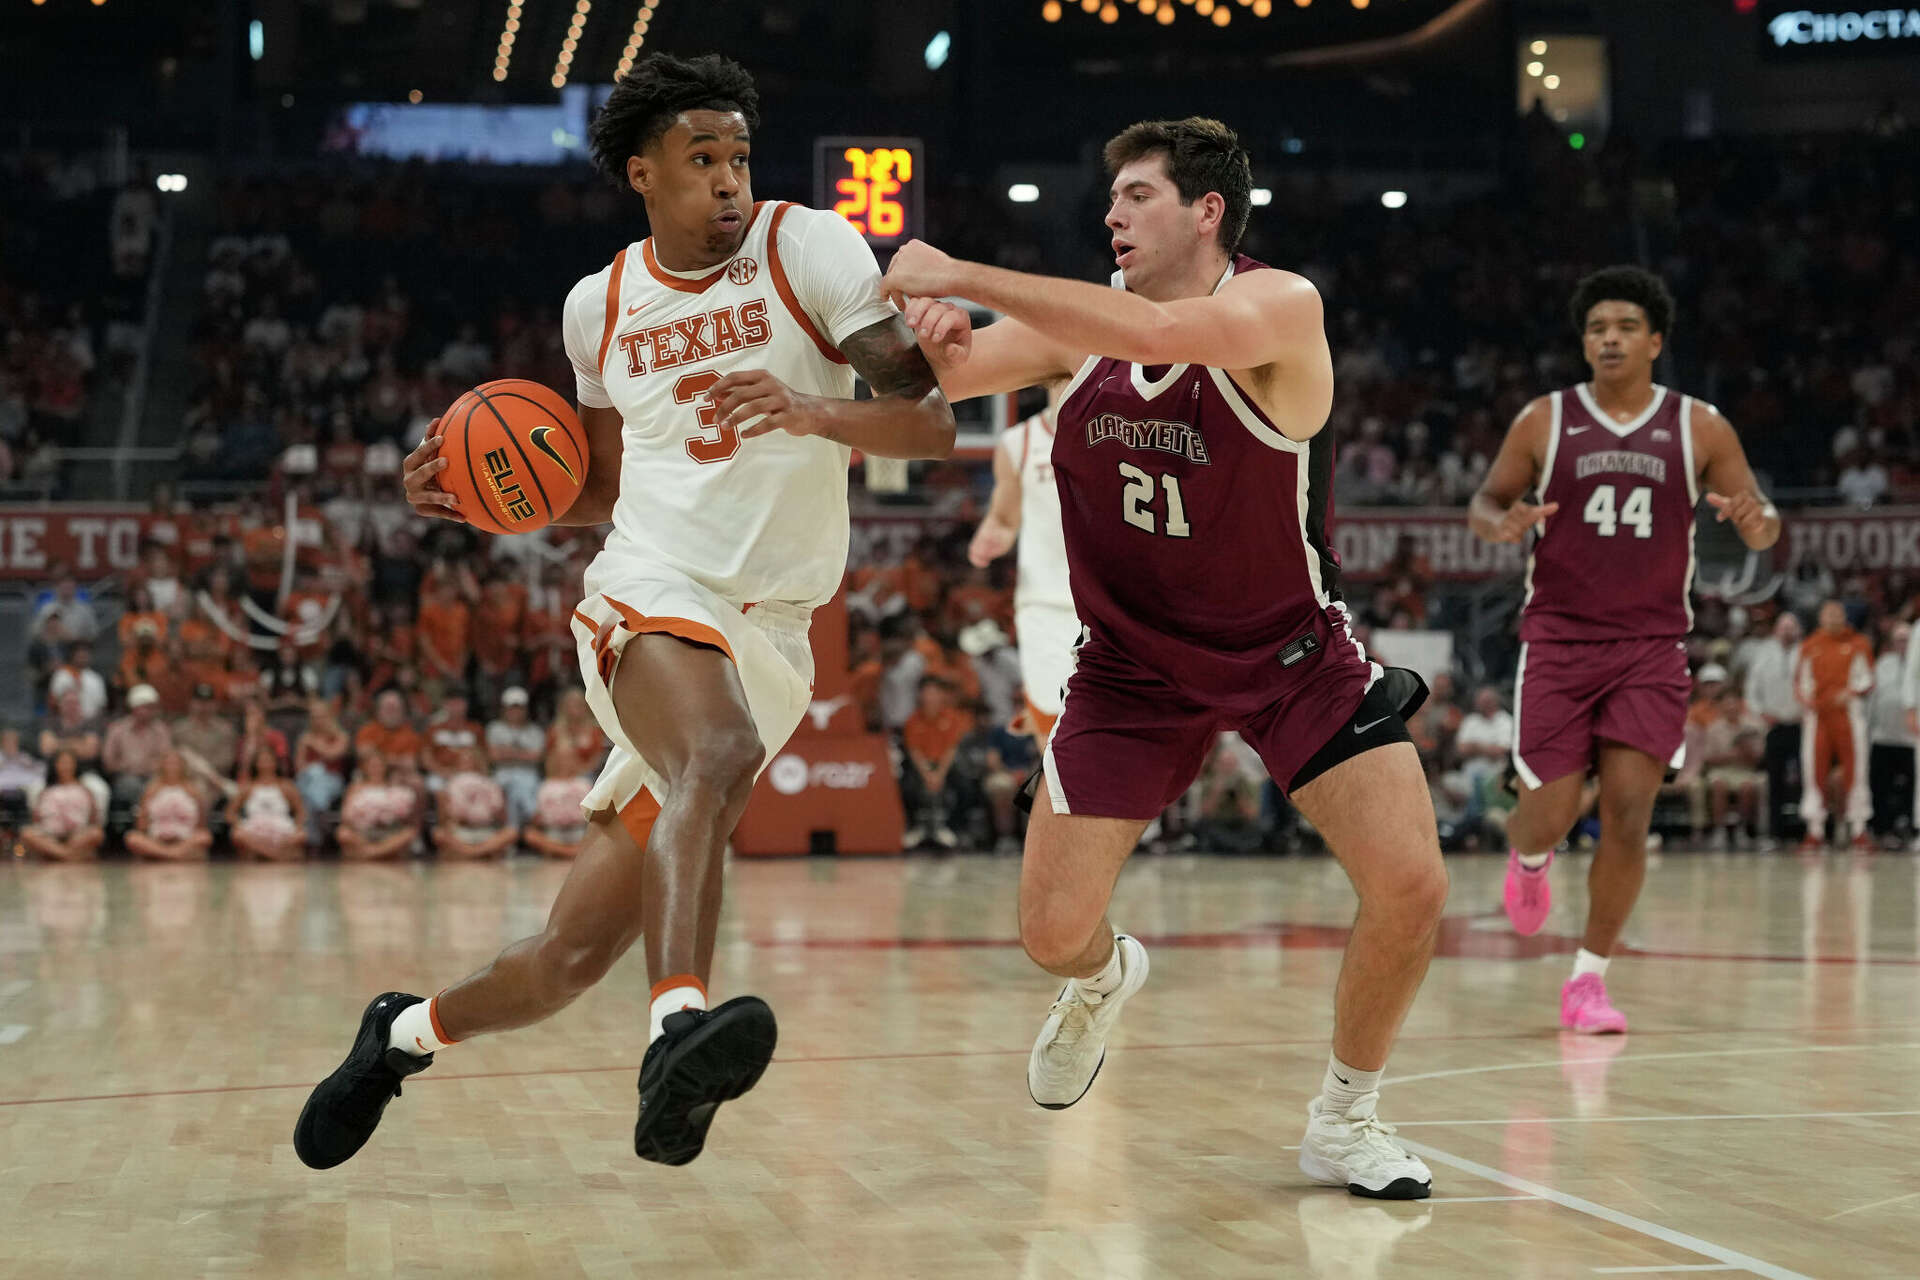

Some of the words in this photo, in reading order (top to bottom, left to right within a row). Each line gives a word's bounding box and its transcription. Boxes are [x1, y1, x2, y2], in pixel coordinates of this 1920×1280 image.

[833, 178, 904, 236] 26
[729, 258, 757, 285] SEC
[618, 298, 772, 378] TEXAS
[672, 369, 741, 464] 3
[484, 447, 537, 521] ELITE
[1118, 460, 1191, 539] 21
[1583, 484, 1654, 539] 44
[67, 517, 140, 570] TO
